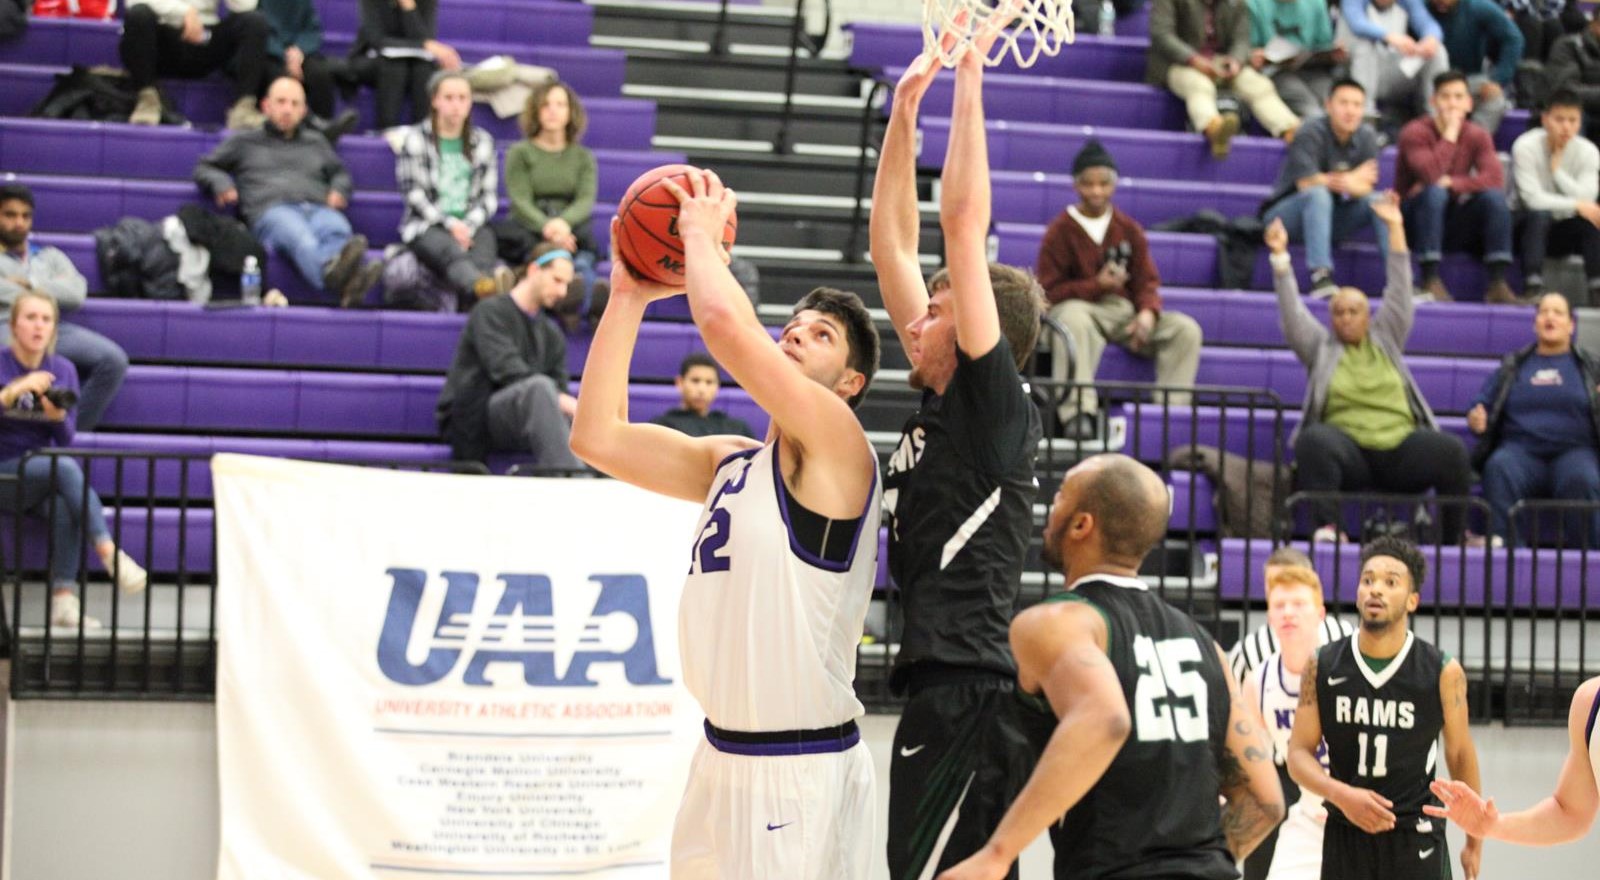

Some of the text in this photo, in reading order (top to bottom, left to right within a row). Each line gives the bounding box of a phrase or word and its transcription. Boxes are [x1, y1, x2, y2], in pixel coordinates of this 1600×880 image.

[377, 567, 674, 687] UAA
[374, 699, 673, 718] UNIVERSITY ATHLETIC ASSOCIATION
[1133, 634, 1209, 743] 25
[1335, 695, 1415, 729] RAMS
[1357, 732, 1388, 777] 11
